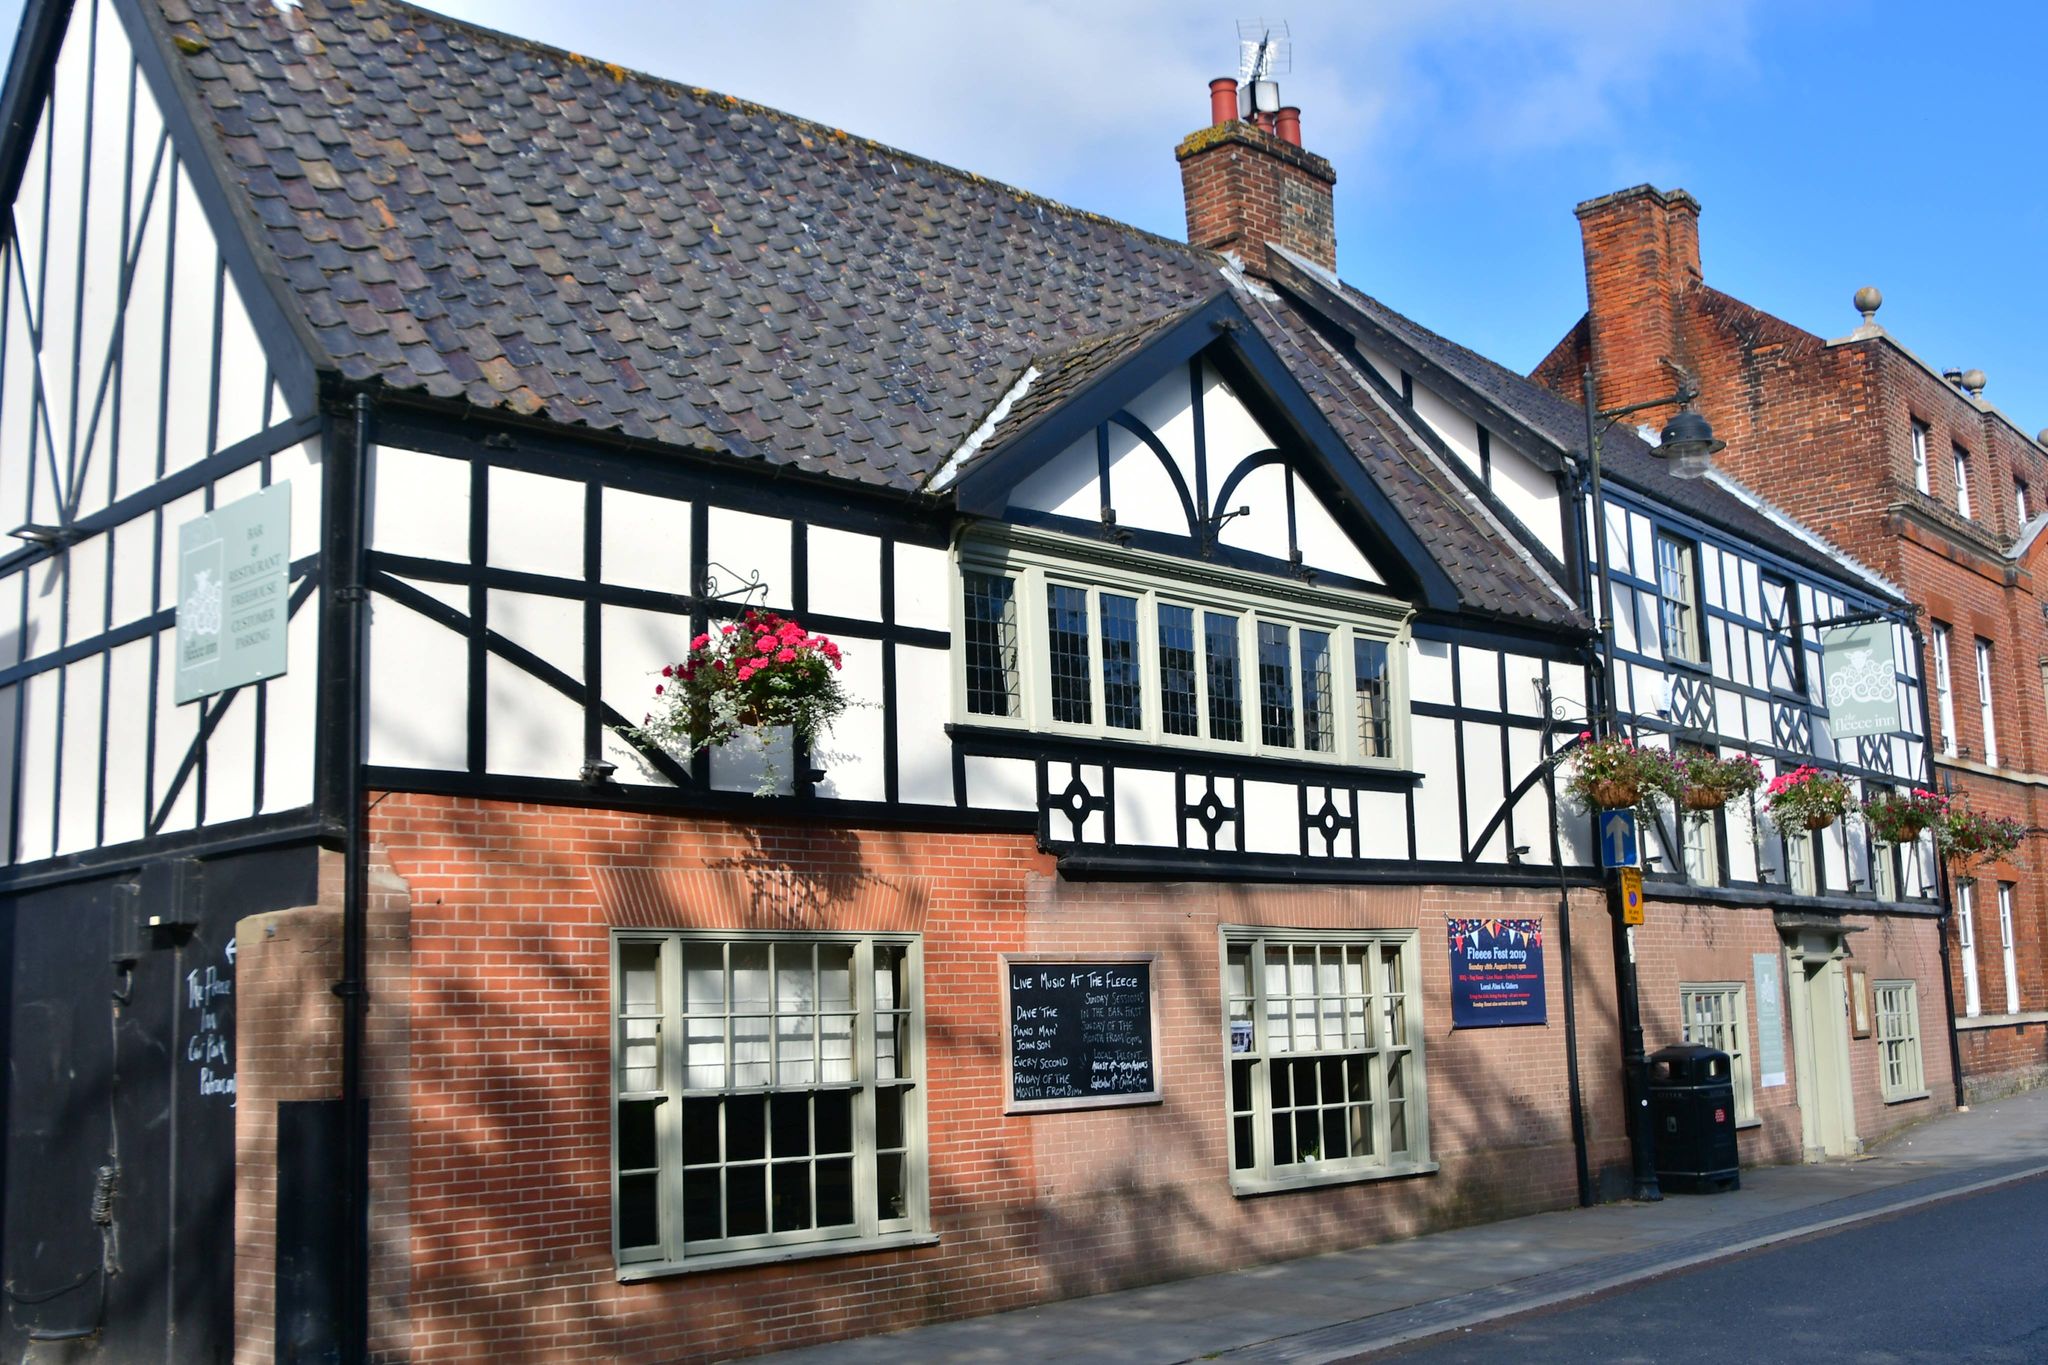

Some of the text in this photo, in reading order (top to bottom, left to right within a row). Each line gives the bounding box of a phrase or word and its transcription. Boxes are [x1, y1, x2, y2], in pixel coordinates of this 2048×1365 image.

[228, 553, 281, 583] RESTAURANT
[231, 608, 275, 634] CUSTOMER
[235, 629, 270, 651] PARKING
[1835, 714, 1895, 732] fleece inn
[1467, 946, 1527, 963] Fleece Fest 2019
[1070, 972, 1084, 989] AT
[1087, 971, 1103, 989] THE
[1092, 1007, 1104, 1017] THE
[1118, 1020, 1133, 1031] THE
[1042, 1074, 1054, 1084] OF
[1054, 1073, 1071, 1085] THE
